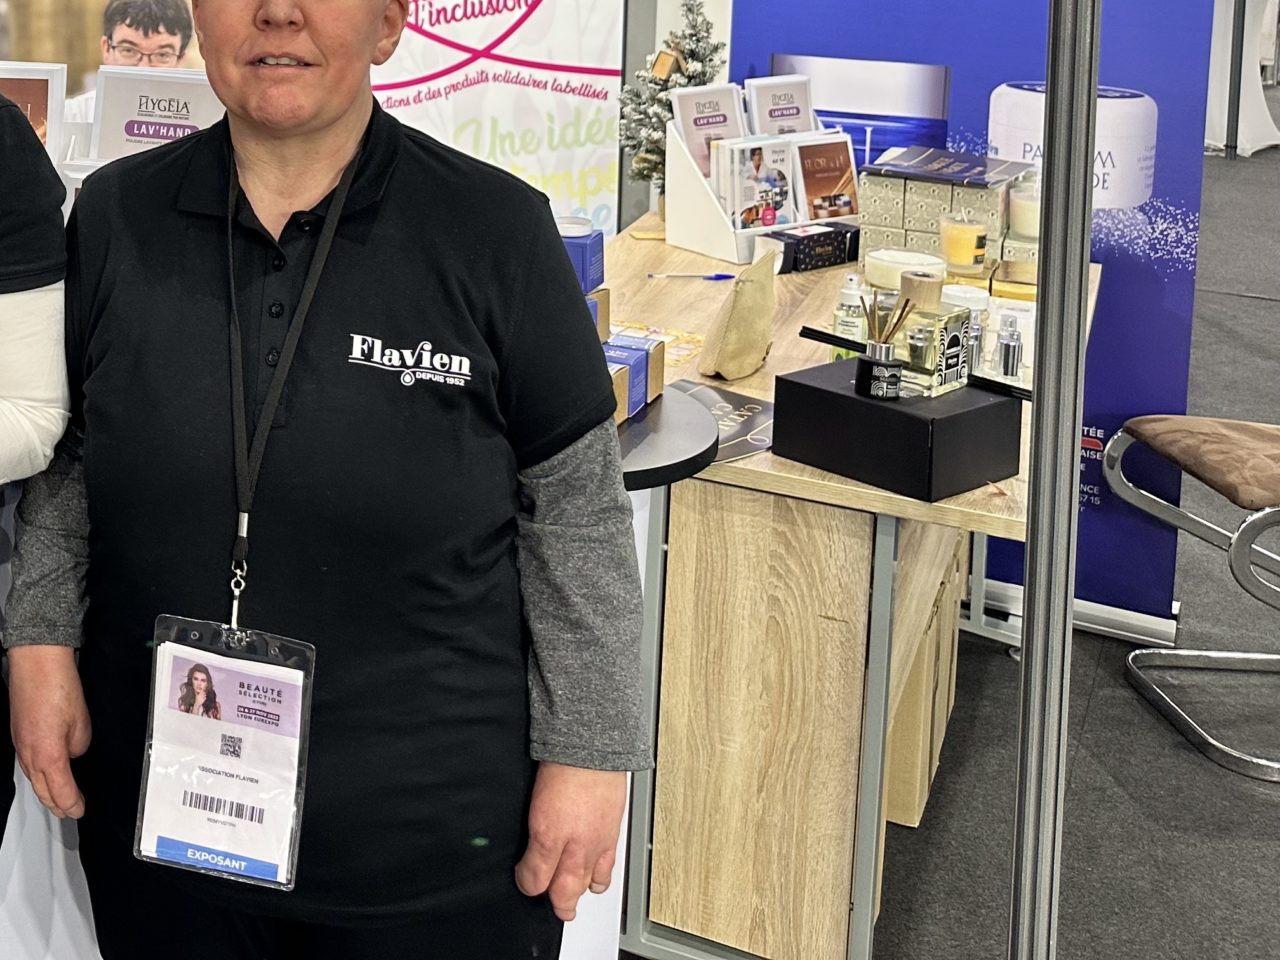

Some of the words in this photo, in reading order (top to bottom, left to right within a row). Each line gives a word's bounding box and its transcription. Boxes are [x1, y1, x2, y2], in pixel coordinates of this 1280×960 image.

[381, 93, 411, 110] ctions
[413, 87, 424, 104] et
[425, 85, 443, 100] des
[444, 69, 490, 100] produits
[491, 70, 548, 91] solidaires
[550, 78, 609, 101] labellisés
[138, 95, 190, 114] HYGEIA
[133, 123, 192, 138] LAV'HAND
[452, 116, 541, 164] Une
[348, 333, 472, 376] Flavien
[415, 371, 445, 384] DEPUIS
[445, 377, 465, 387] 1952
[238, 681, 283, 698] BEAUTÉ
[187, 848, 248, 871] EXPOSANT
